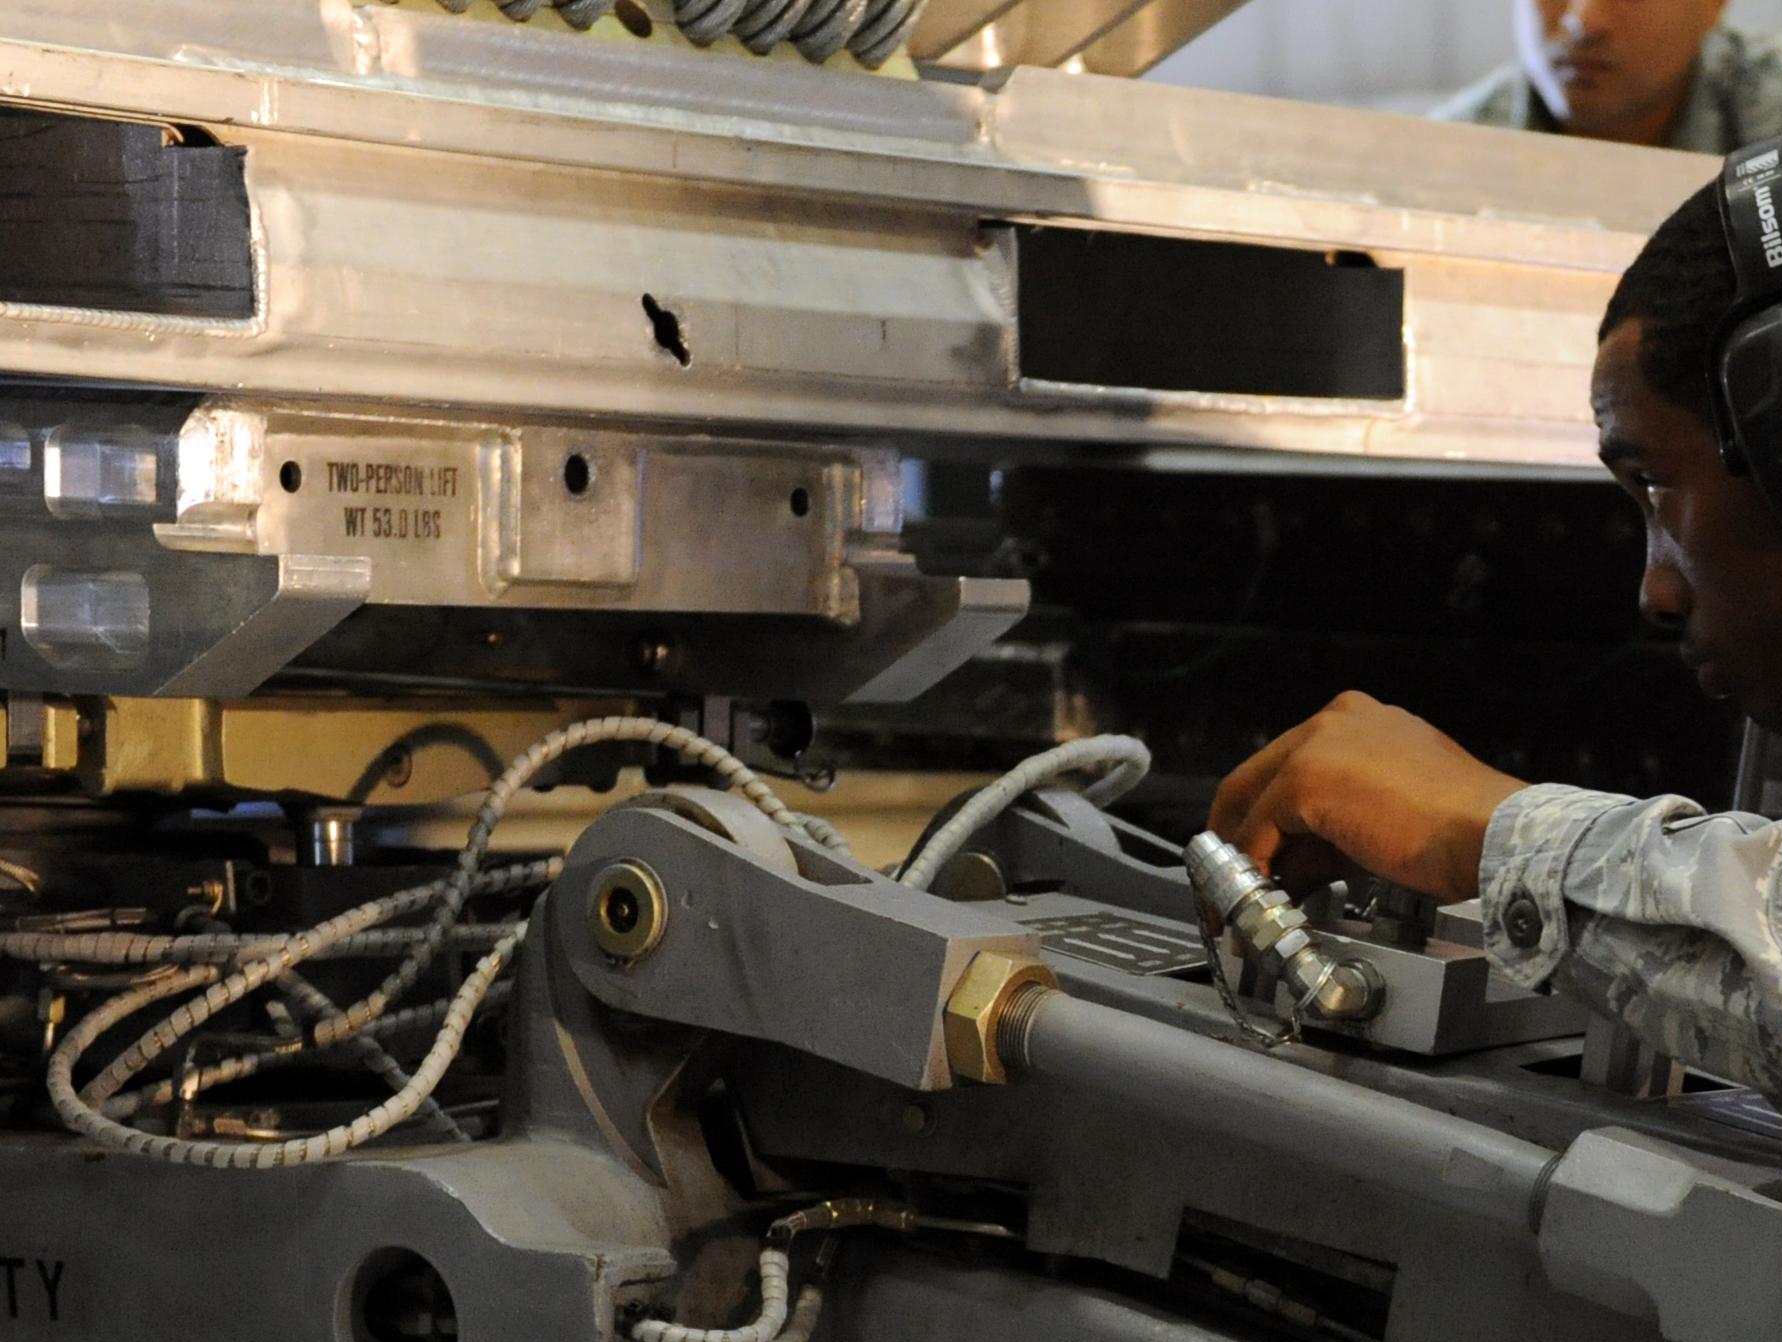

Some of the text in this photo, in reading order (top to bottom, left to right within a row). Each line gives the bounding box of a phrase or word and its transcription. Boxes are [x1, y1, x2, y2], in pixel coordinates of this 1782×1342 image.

[327, 461, 458, 497] TWO-PERSON LIFT
[344, 506, 441, 539] WT 53.0 LBS
[0, 1257, 64, 1321] TY
